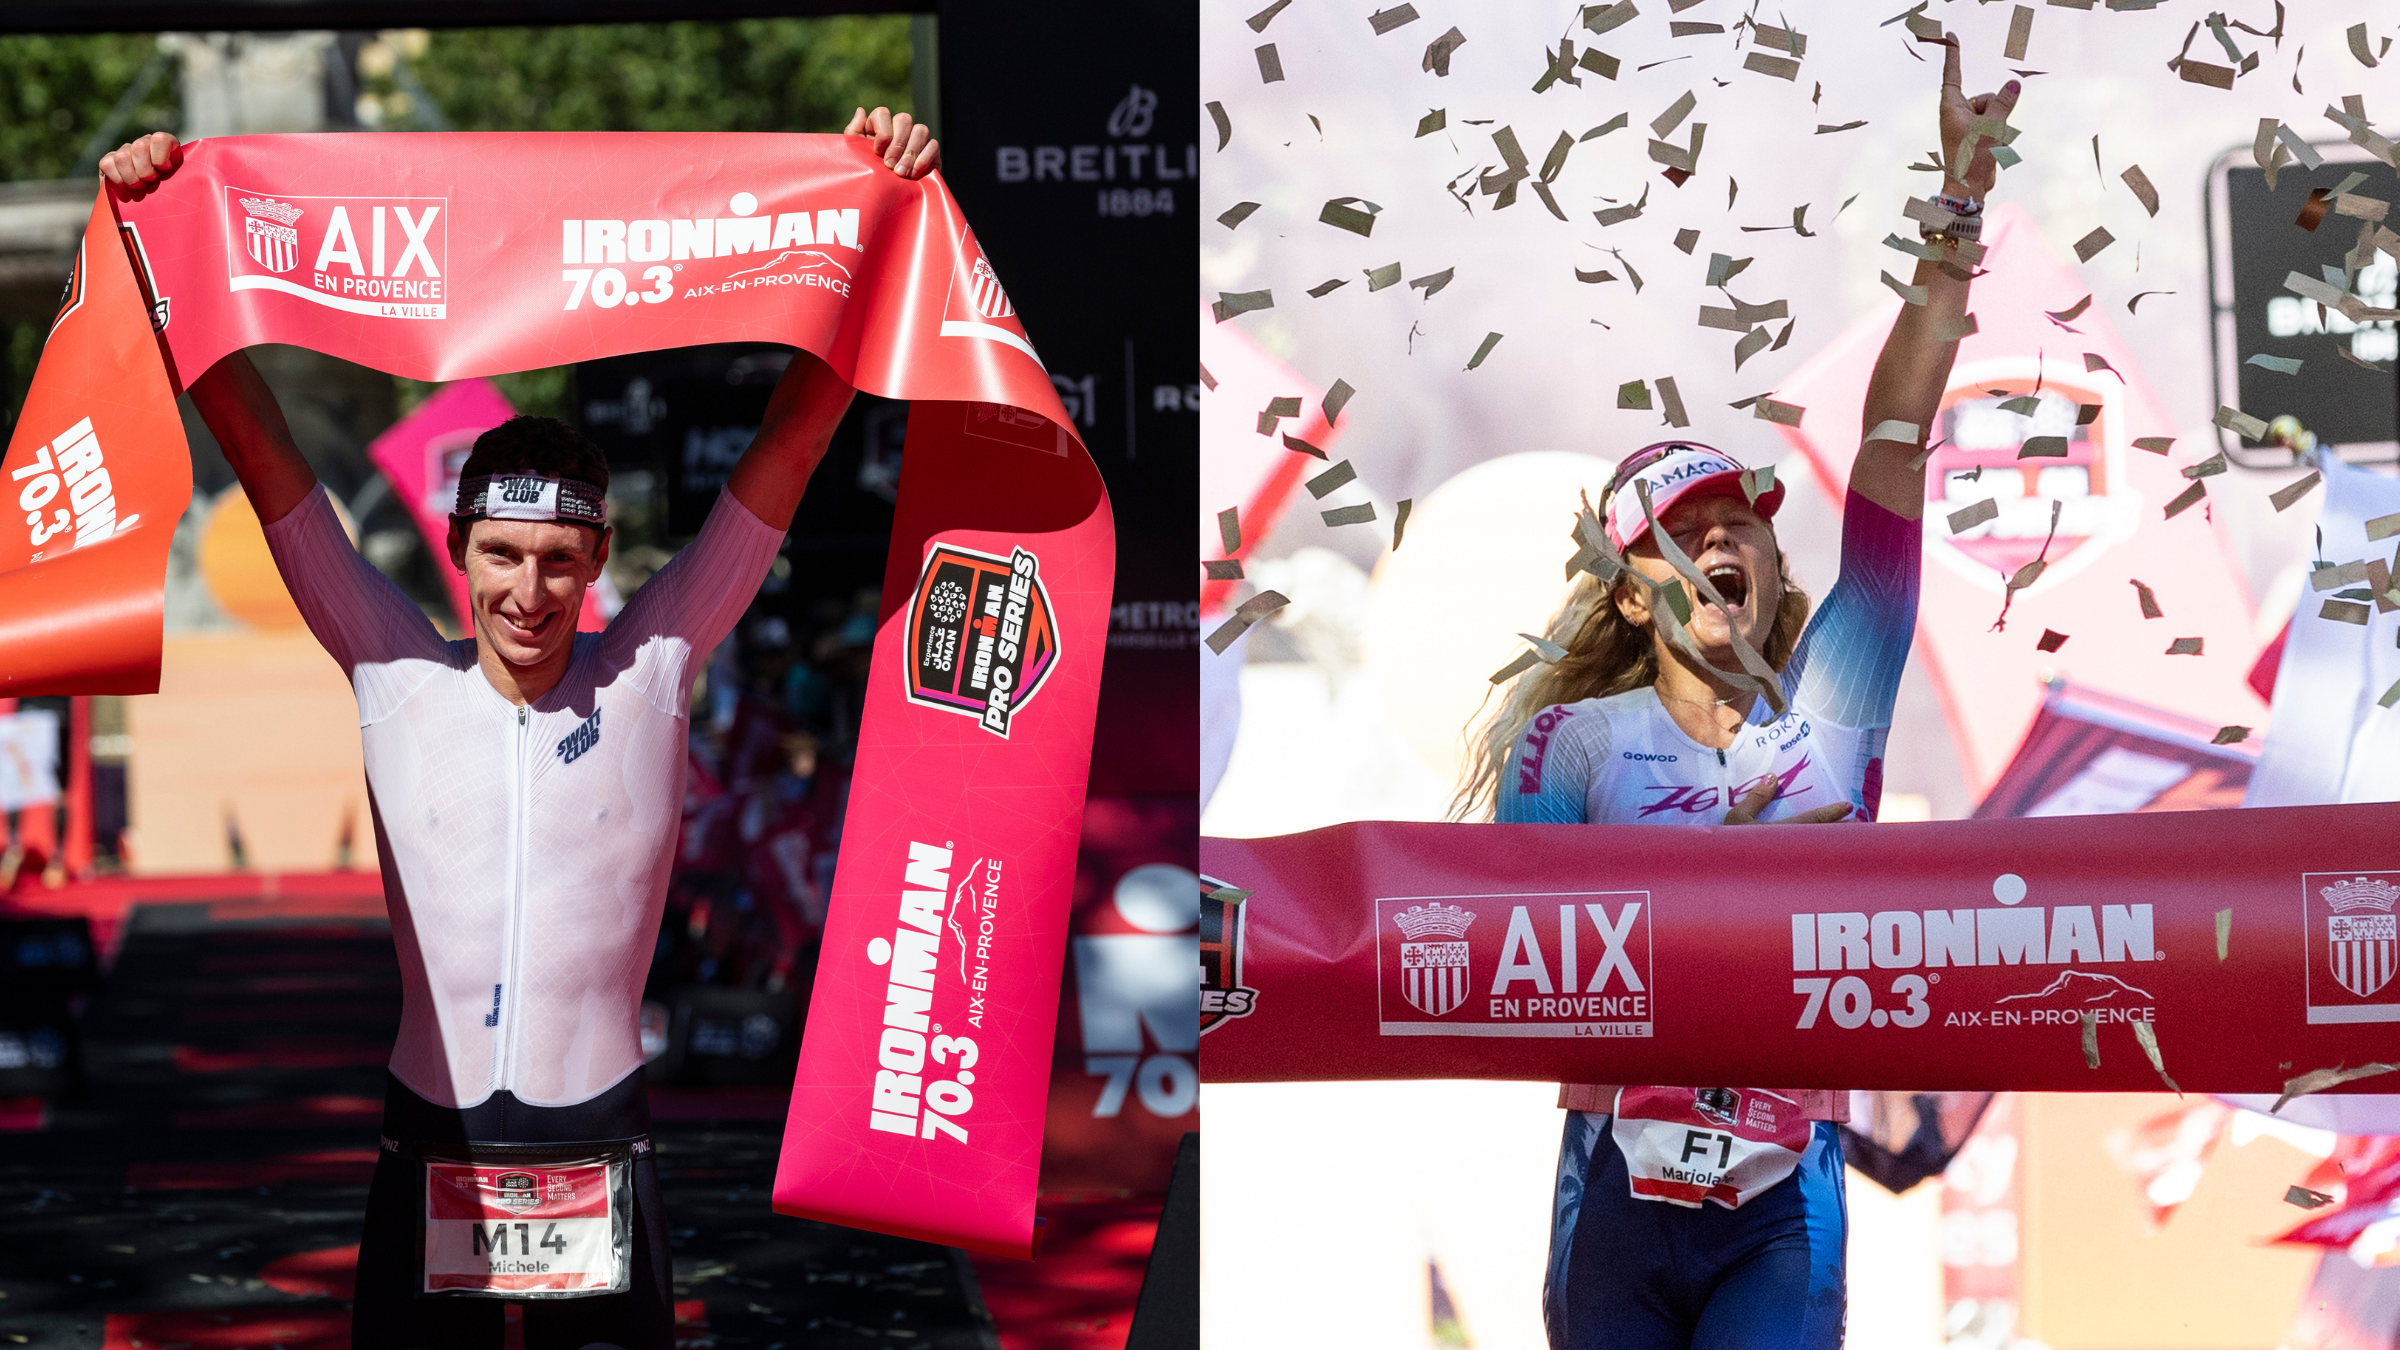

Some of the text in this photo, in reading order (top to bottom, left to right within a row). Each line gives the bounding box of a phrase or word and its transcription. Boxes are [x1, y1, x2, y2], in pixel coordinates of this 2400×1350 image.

[314, 206, 441, 277] AIX
[562, 209, 860, 264] IRONMAN
[314, 272, 442, 299] EN PROVENCE
[562, 265, 674, 311] 70.3
[683, 272, 851, 299] AIX-EN-PROVENCE
[381, 305, 438, 317] LA VILLE
[11, 445, 71, 546] 70.3
[497, 477, 550, 491] SWATT
[502, 489, 540, 504] CLUB
[923, 625, 936, 667] Experience
[941, 629, 957, 672] OMAN
[970, 584, 1004, 690] IRONMAN
[985, 553, 1034, 731] PRO SERIES
[557, 706, 602, 757] SWATT
[564, 728, 600, 764] CLUB
[1622, 751, 1679, 763] GOWOD
[968, 858, 1003, 1029] AIX-EN-PROVENCE
[1490, 902, 1646, 996] AIX
[1792, 903, 2155, 972] IRONMAN
[869, 841, 953, 1137] IRONMAN
[1489, 996, 1647, 1018] EN PROVENCE
[1793, 974, 1931, 1030] 70.3
[1575, 1025, 1644, 1036] LA VILLE
[921, 1034, 979, 1144] 70.3
[1749, 1098, 1773, 1112] EVERY
[1745, 1117, 1777, 1133] MATTERS
[1747, 1107, 1776, 1124] SECOND
[1680, 1130, 1733, 1169] F1
[547, 1174, 567, 1184] EVERY
[547, 1184, 573, 1193] SECOND
[547, 1192, 576, 1201] MATTERS
[472, 1223, 568, 1256] M14
[488, 1260, 551, 1274] Michele
